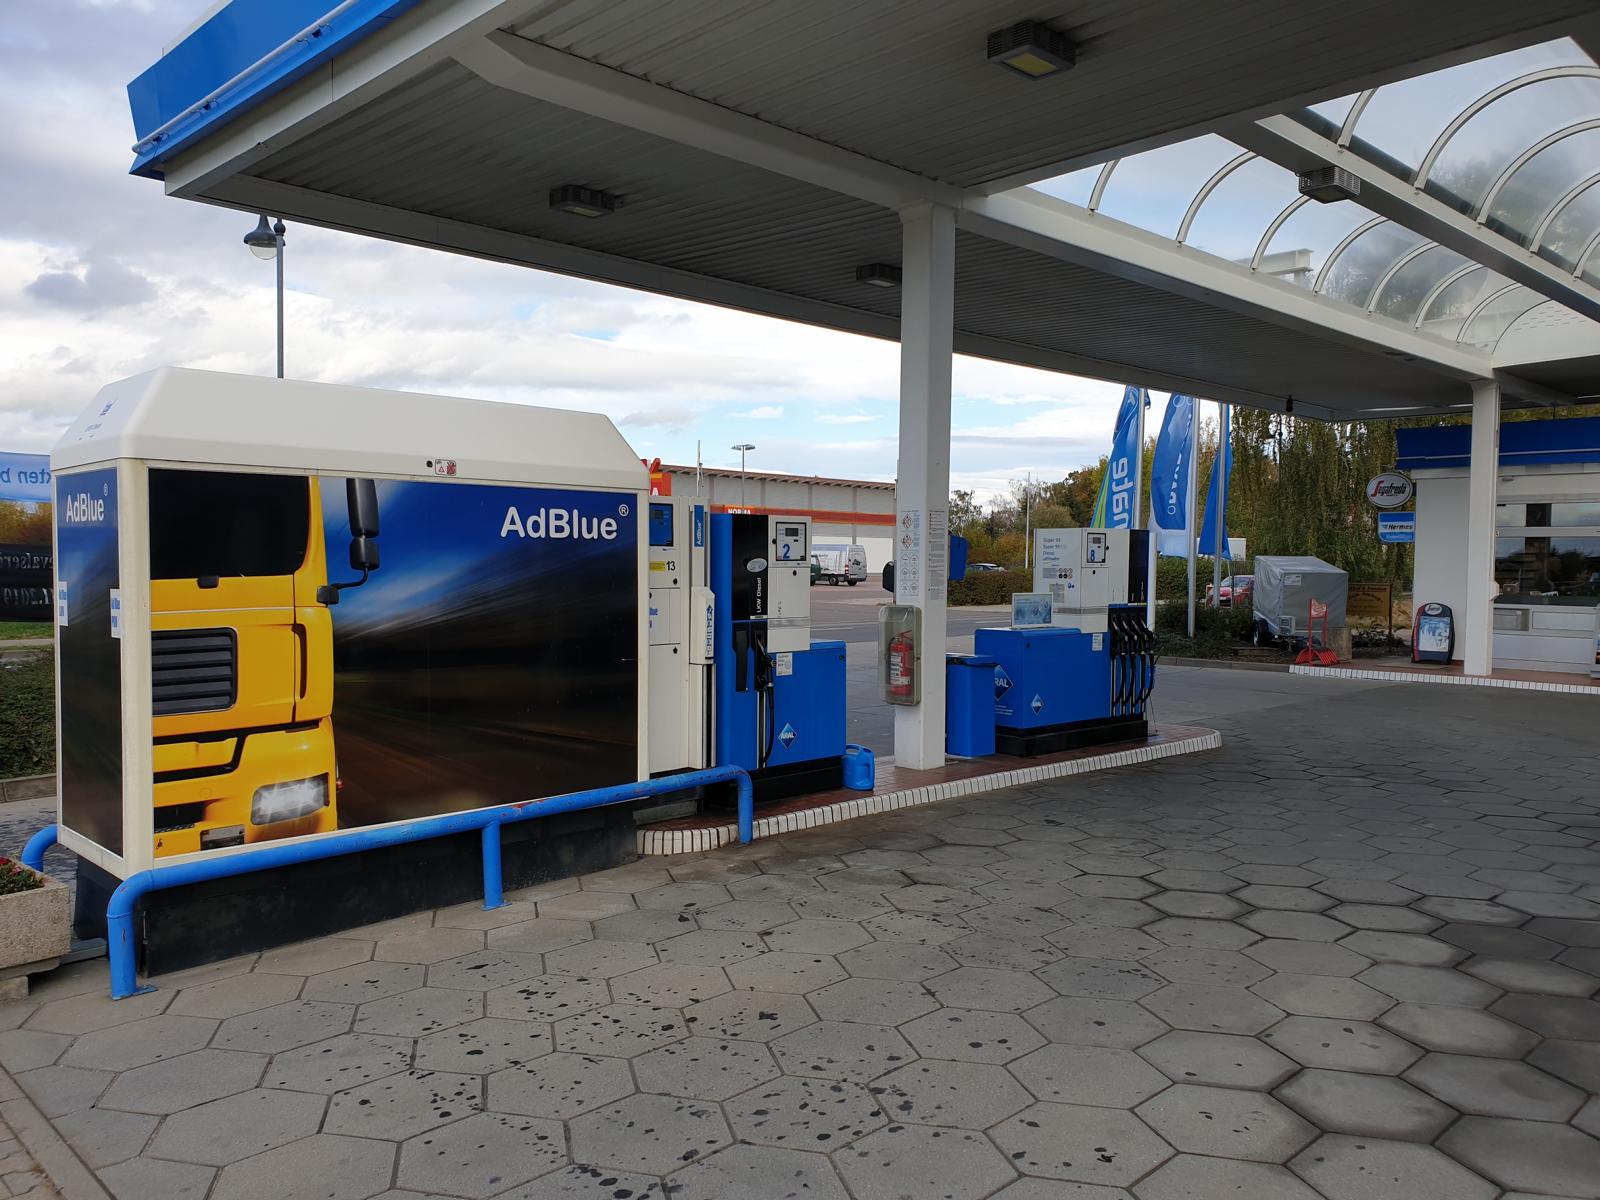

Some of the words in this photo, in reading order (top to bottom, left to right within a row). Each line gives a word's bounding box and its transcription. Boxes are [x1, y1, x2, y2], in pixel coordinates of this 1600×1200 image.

[783, 543, 791, 559] 2
[1090, 550, 1096, 561] 8
[666, 561, 676, 571] 13
[994, 677, 1010, 688] RAL
